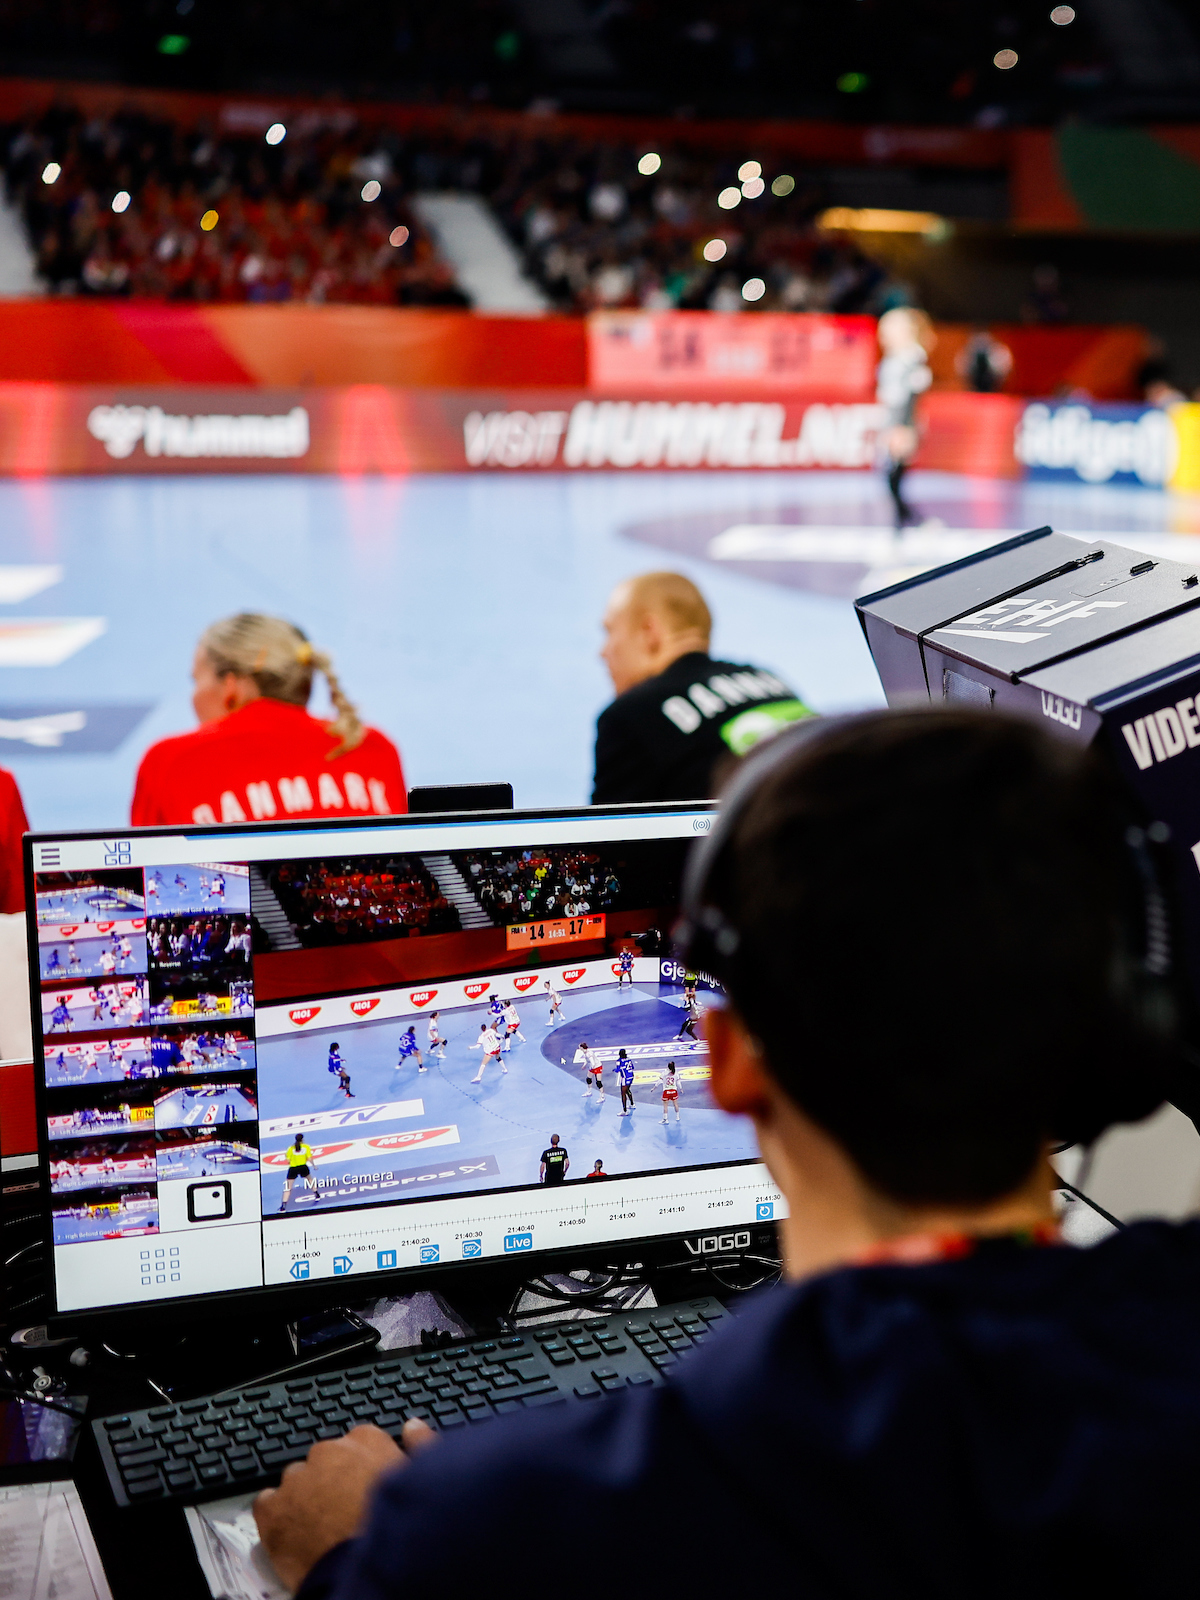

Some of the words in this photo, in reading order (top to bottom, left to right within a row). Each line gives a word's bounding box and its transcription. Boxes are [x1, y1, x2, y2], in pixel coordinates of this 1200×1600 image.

[952, 598, 1128, 627] EHF
[529, 924, 544, 940] 14
[569, 919, 584, 935] 17
[564, 970, 579, 979] MOL
[515, 977, 531, 987] MOL
[466, 985, 482, 994] MOL
[412, 992, 429, 1002] MOL
[353, 1001, 371, 1011] MOL
[292, 1008, 311, 1019] MOL
[330, 1106, 387, 1125] TV
[376, 1133, 424, 1146] MOL
[282, 1181, 289, 1192] 1
[303, 1176, 338, 1190] Main
[342, 1170, 394, 1185] Camera
[294, 1170, 457, 1203] GRUNDFOS
[755, 1194, 781, 1203] 21:41:30
[707, 1200, 734, 1209] 21:41:20
[659, 1206, 685, 1214] 21:41:10
[609, 1212, 636, 1220] 21:41:00
[559, 1218, 586, 1227] 21:40:50
[507, 1224, 535, 1233] 21:40:40
[454, 1231, 483, 1240] 21:40:30
[401, 1237, 430, 1246] 21:40:20
[506, 1236, 531, 1249] Live
[684, 1231, 750, 1255] VOGO
[347, 1244, 376, 1253] 21:40:10
[291, 1251, 321, 1260] 21:40:00
